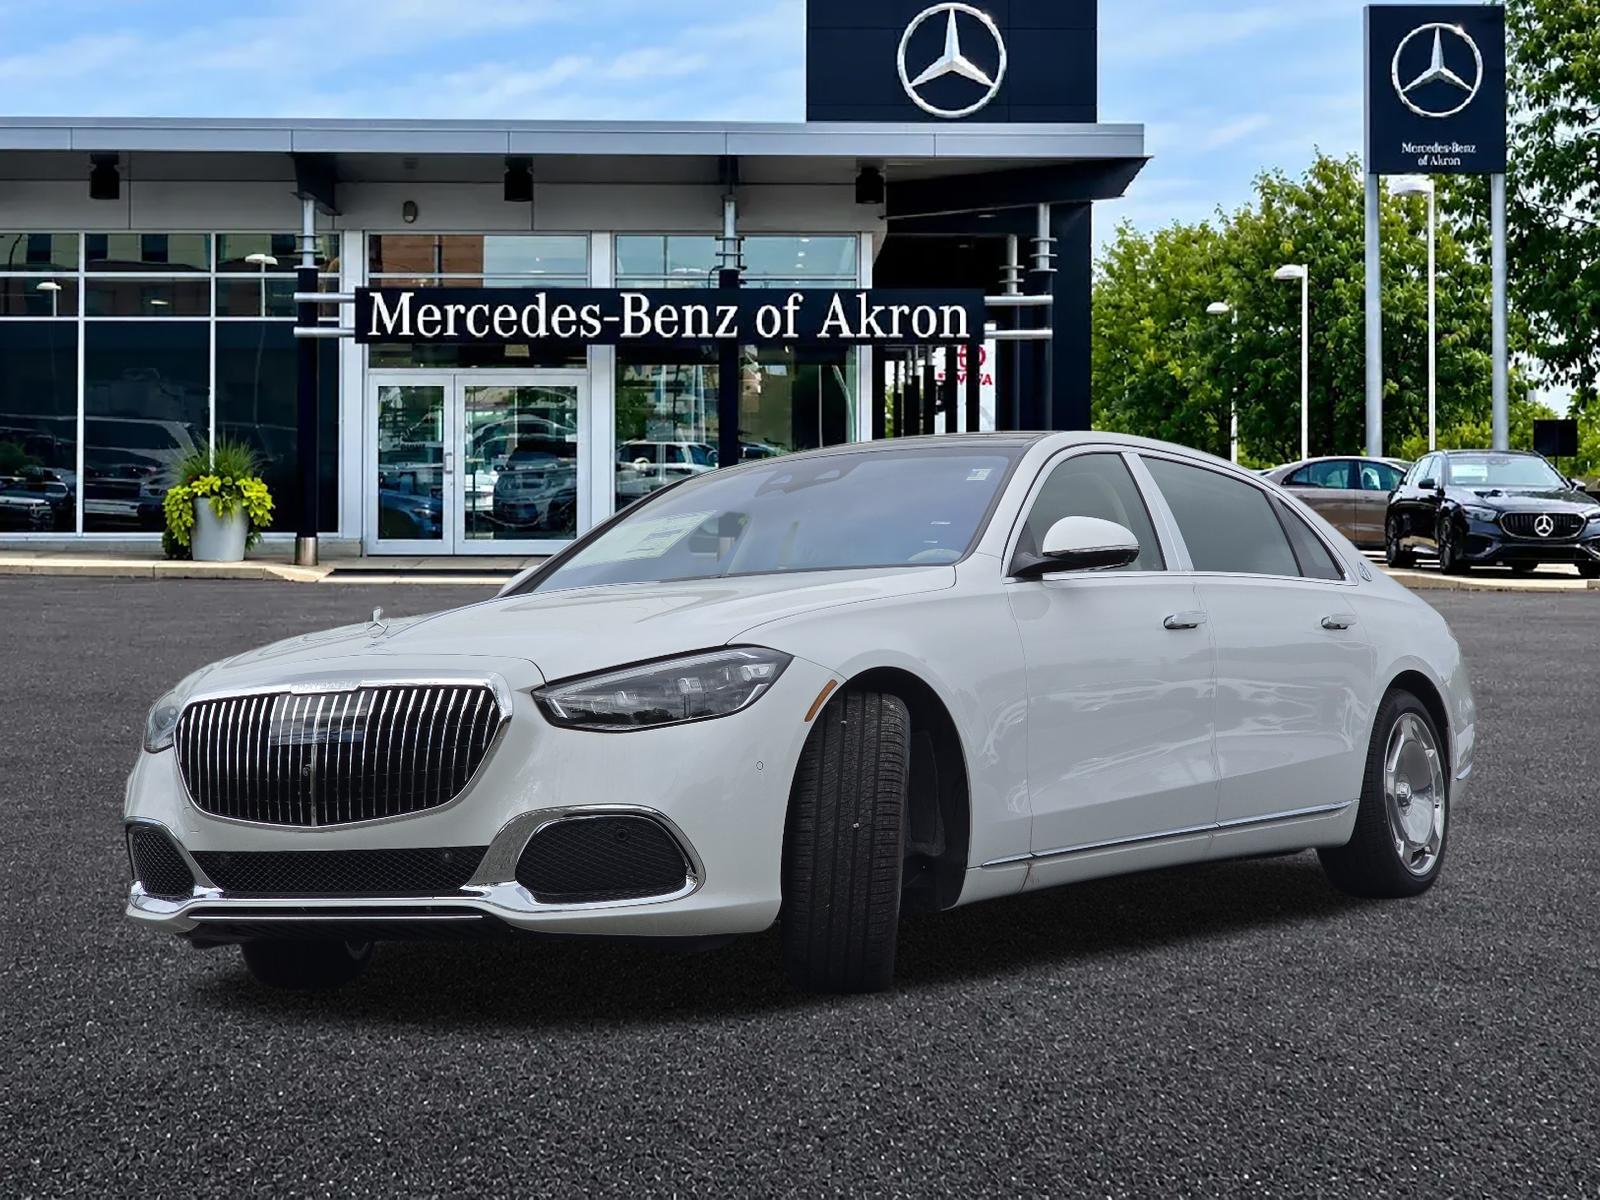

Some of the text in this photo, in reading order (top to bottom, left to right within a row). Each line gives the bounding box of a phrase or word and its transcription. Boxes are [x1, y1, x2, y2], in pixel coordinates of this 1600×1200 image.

[1401, 141, 1477, 154] Mercedes-Benz
[1417, 154, 1461, 166] of Akron
[367, 291, 971, 339] Mercedes-Benz of Akron
